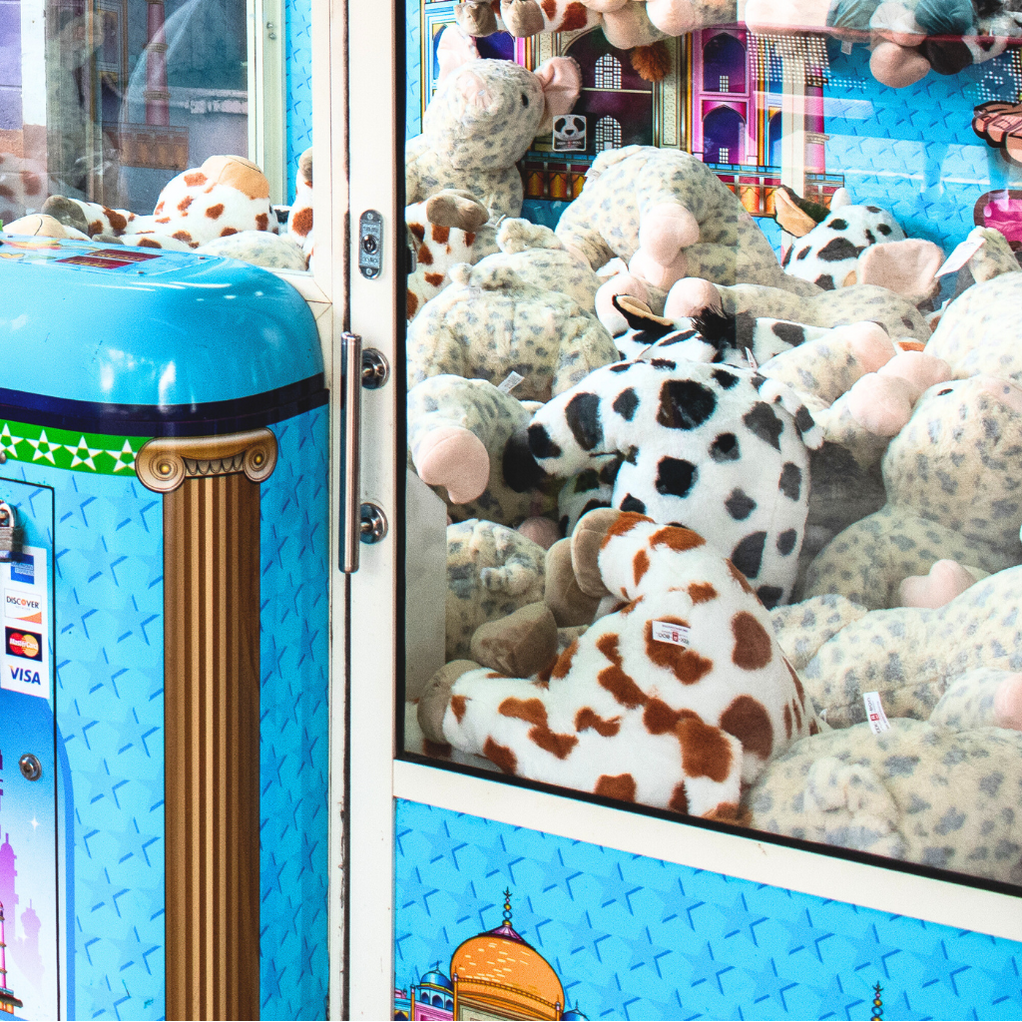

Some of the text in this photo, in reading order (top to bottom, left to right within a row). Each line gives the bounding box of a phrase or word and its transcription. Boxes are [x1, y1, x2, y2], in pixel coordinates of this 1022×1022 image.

[6, 595, 40, 609] DISCOVER
[9, 637, 38, 651] MasterCard
[9, 665, 41, 686] VISA
